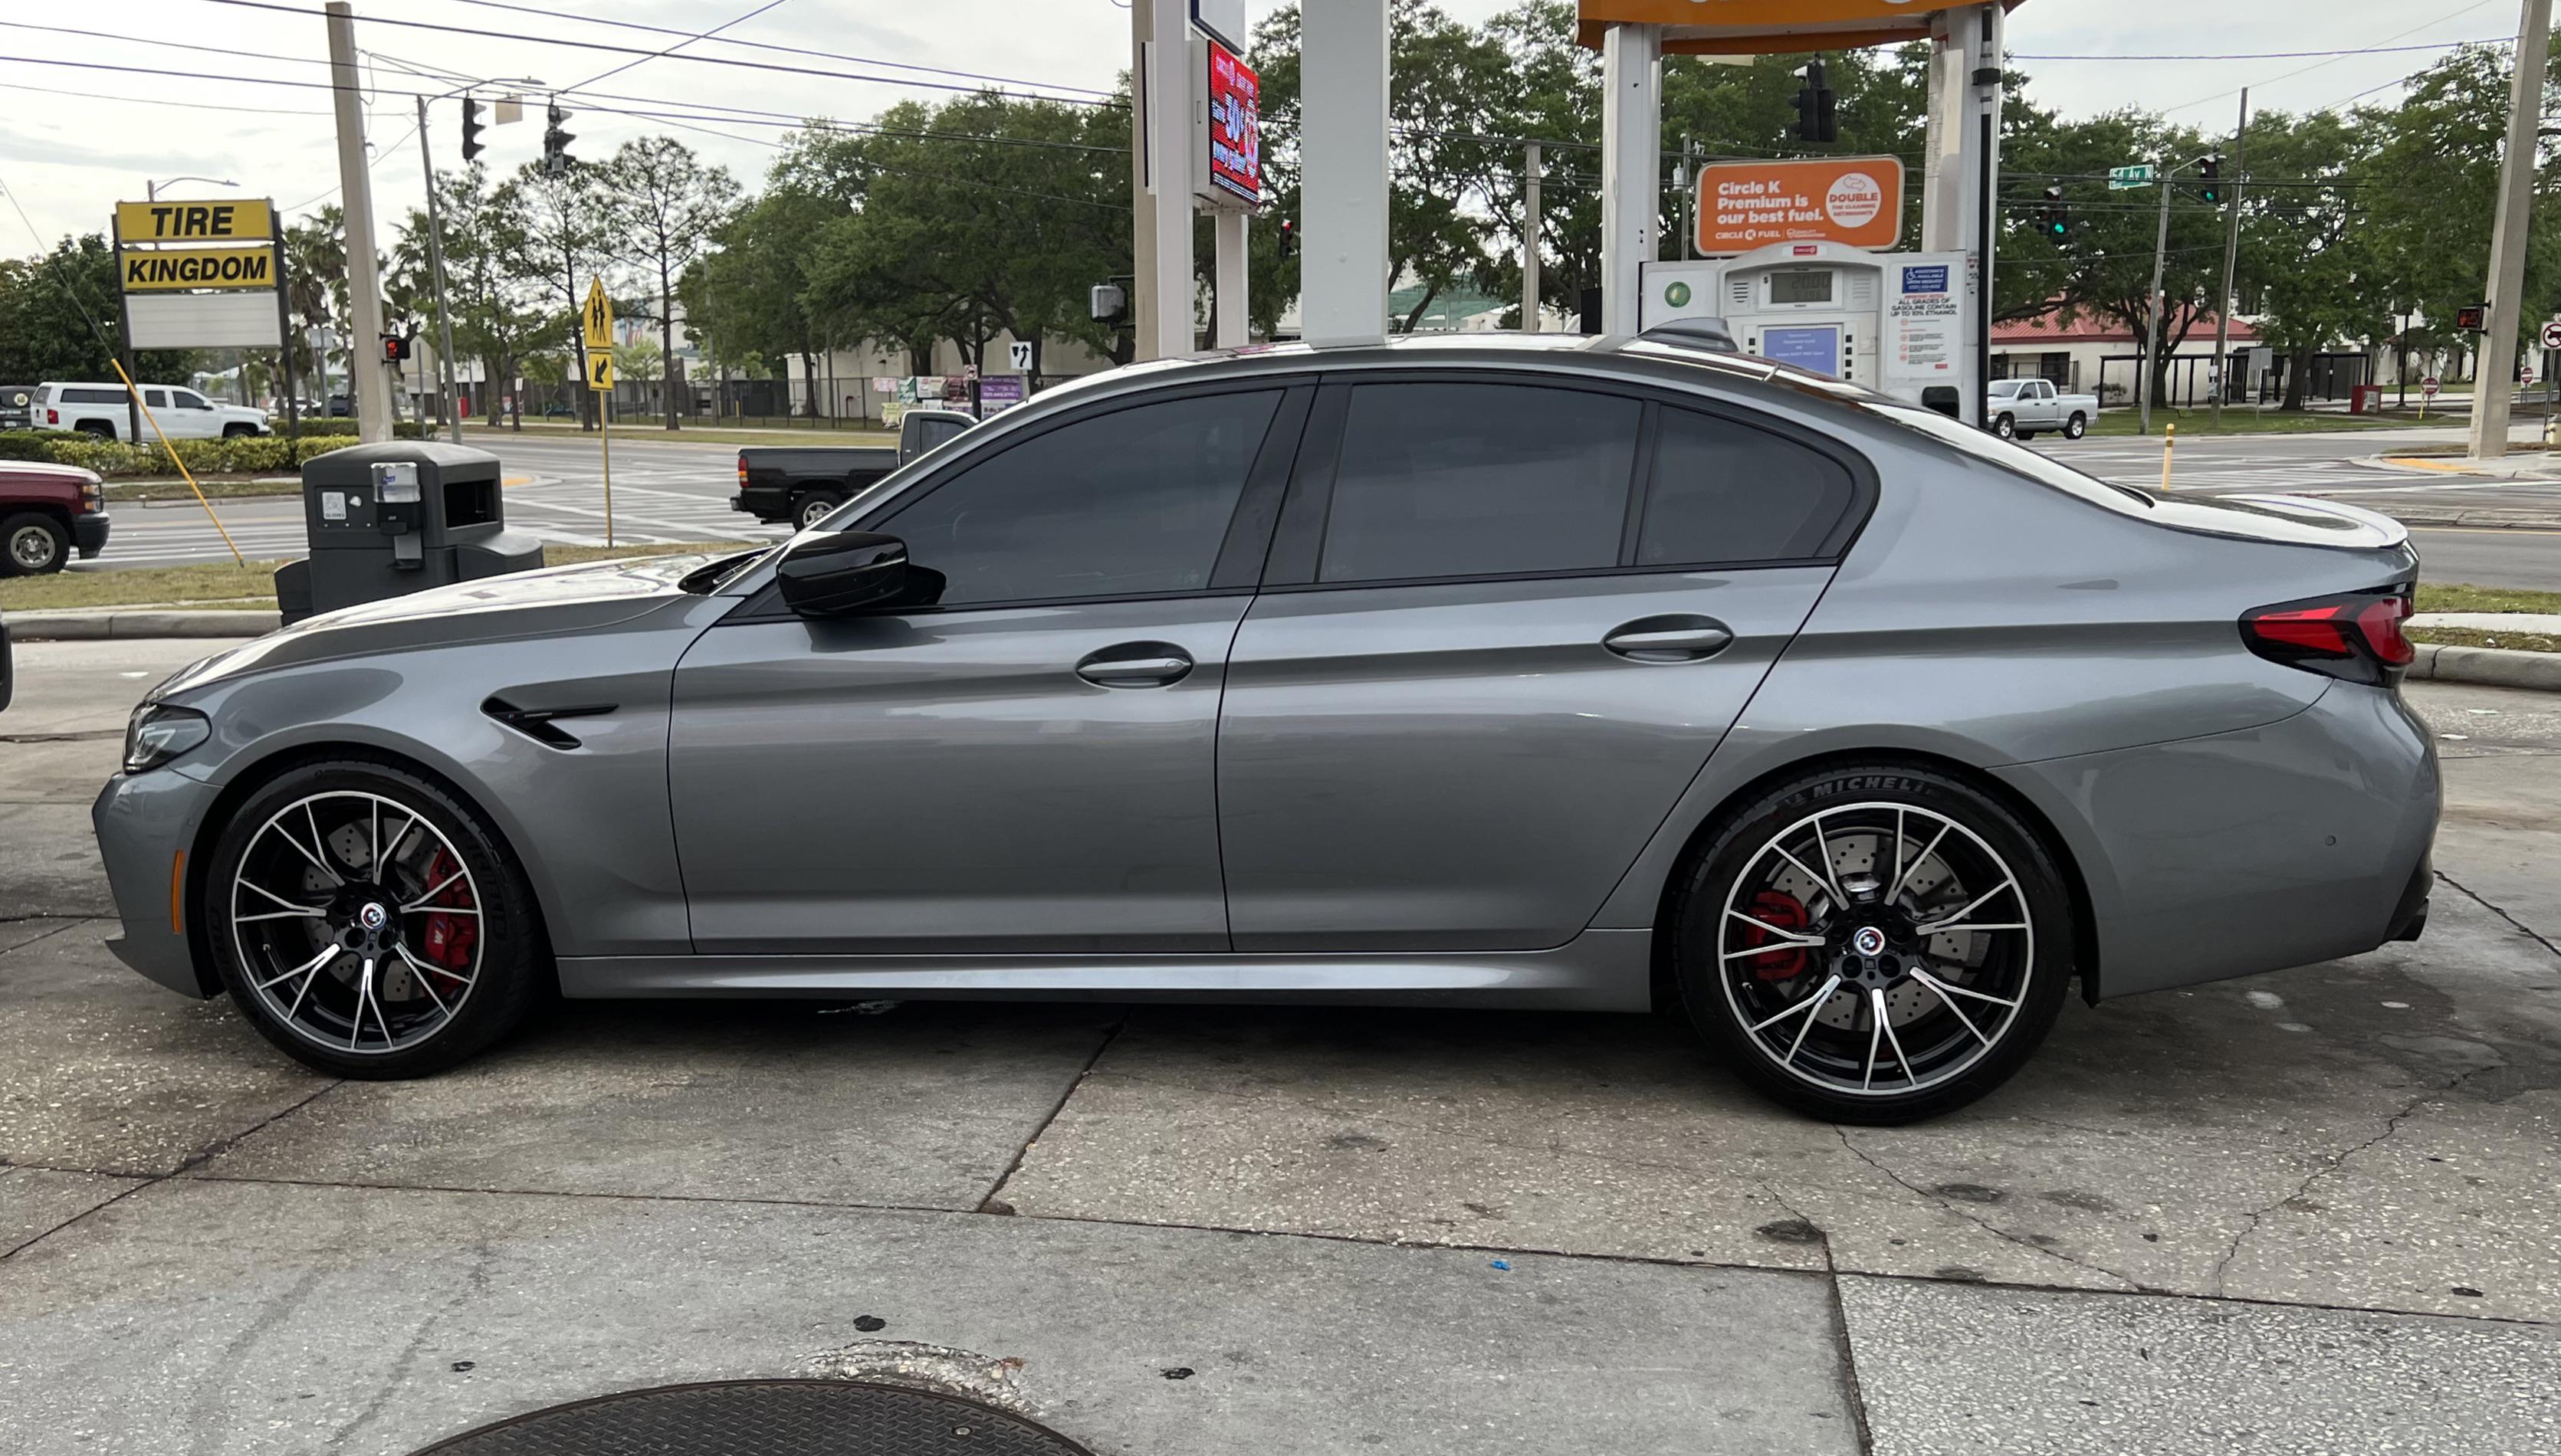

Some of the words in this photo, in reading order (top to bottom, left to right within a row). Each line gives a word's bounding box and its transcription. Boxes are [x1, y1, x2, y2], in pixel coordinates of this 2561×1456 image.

[1718, 181, 1764, 195] Circle
[1768, 180, 1781, 193] K
[1717, 195, 1791, 210] Premium
[1795, 194, 1808, 207] is
[1829, 192, 1878, 202] DOUBLE
[151, 206, 235, 237] TIRE
[1717, 213, 1745, 225] our
[1748, 210, 1784, 223] best
[1788, 208, 1824, 222] fuel.
[1716, 231, 1743, 240] CIRCLE
[1758, 230, 1781, 238] FUEL
[127, 256, 267, 283] KINGDOM
